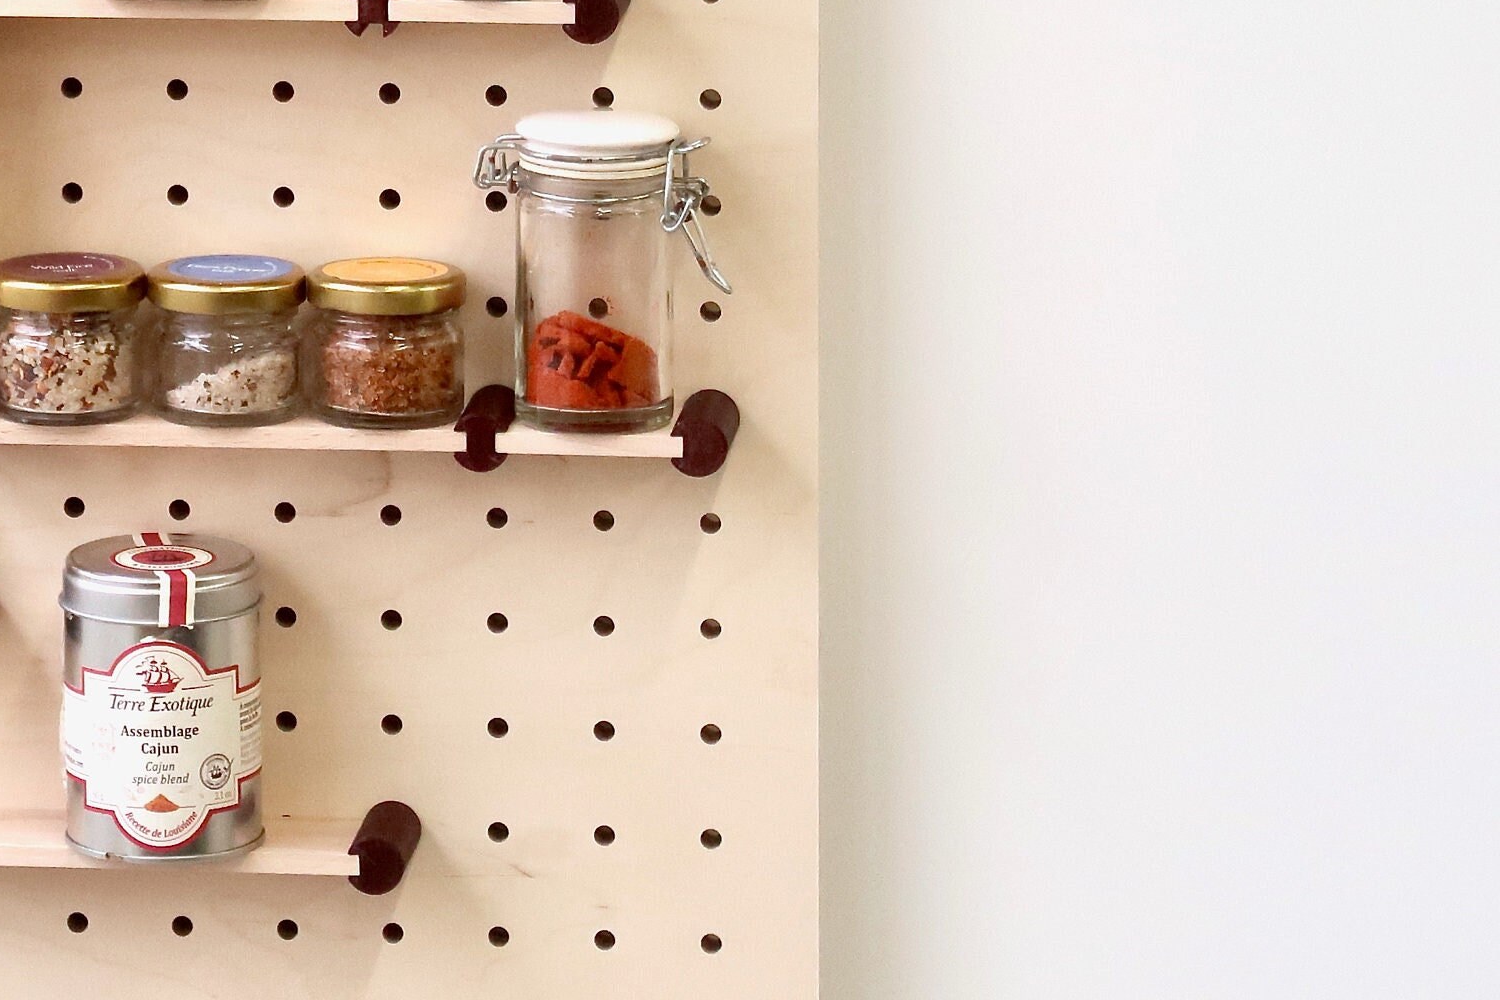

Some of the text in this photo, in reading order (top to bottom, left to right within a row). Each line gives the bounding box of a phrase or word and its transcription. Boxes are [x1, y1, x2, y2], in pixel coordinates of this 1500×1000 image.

[109, 693, 214, 717] Terre Exotique
[120, 724, 200, 740] Assemblage
[140, 742, 180, 758] Cajun
[144, 760, 176, 775] Cajun
[131, 772, 190, 786] spice blend
[124, 810, 198, 839] Recette de Louisiane
